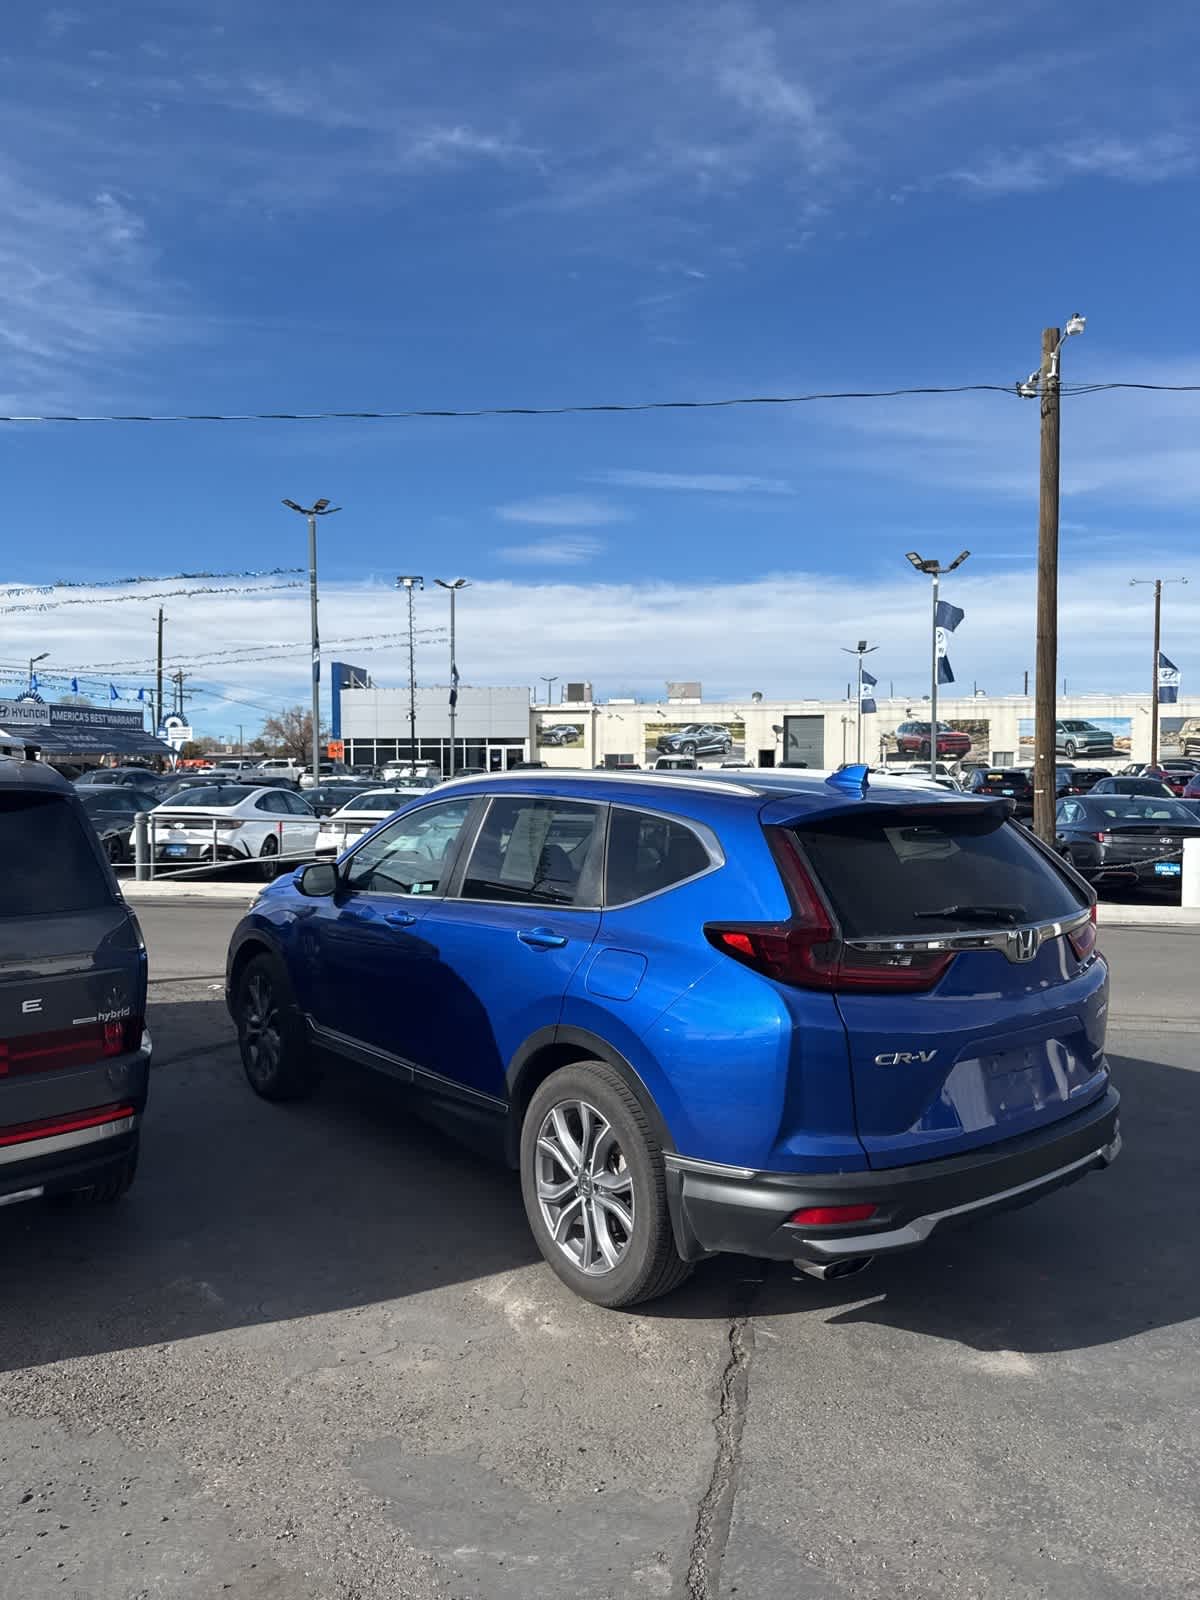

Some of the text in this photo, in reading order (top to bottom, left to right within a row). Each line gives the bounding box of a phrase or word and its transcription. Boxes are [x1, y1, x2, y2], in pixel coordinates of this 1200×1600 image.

[51, 711, 142, 726] AMERICA'S BEST WARRANTY
[22, 998, 43, 1013] E
[98, 1007, 130, 1021] hybrid
[875, 1049, 938, 1066] CR-V
